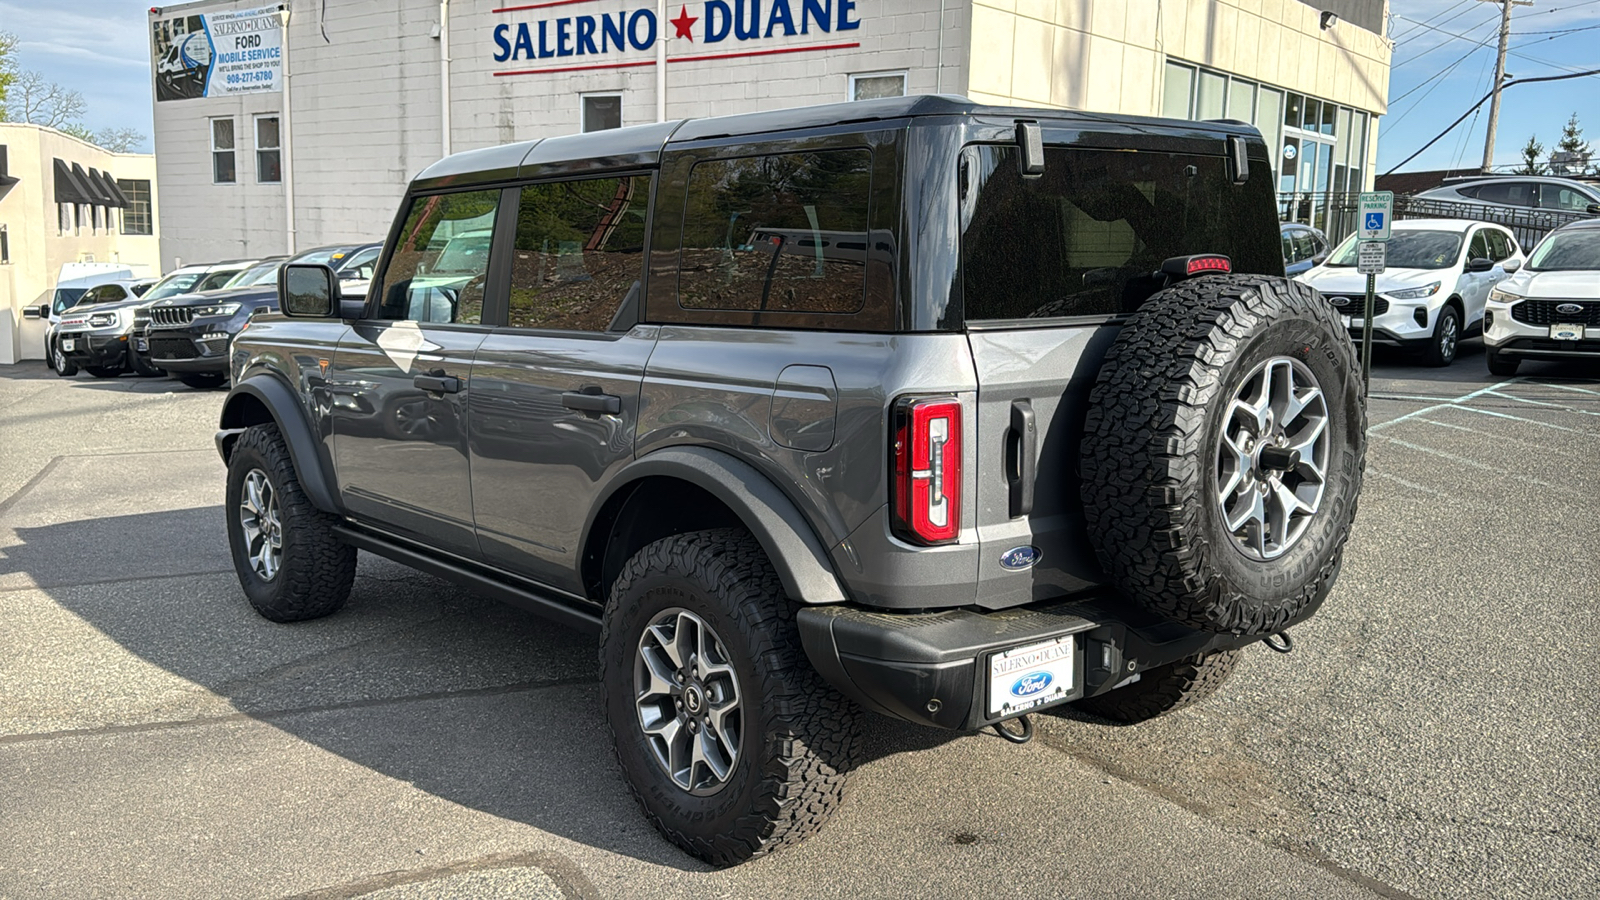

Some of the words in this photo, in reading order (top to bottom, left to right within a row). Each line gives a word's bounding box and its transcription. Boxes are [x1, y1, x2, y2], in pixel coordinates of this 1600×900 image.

[213, 20, 247, 35] SALERNO
[493, 8, 657, 62] SALERNO
[703, 0, 861, 43] DUANE
[235, 34, 261, 49] FORD
[218, 51, 246, 64] MOBILE
[247, 47, 280, 61] SERVICE
[231, 64, 243, 72] BRING
[227, 70, 273, 84] 908-277-6780
[1011, 552, 1034, 566] Ford
[993, 654, 1036, 675] SALERNO
[1040, 643, 1071, 662] DUANE
[1018, 674, 1047, 695] Ford
[1000, 700, 1035, 717] SALERNO
[1044, 690, 1068, 704] DUANE
